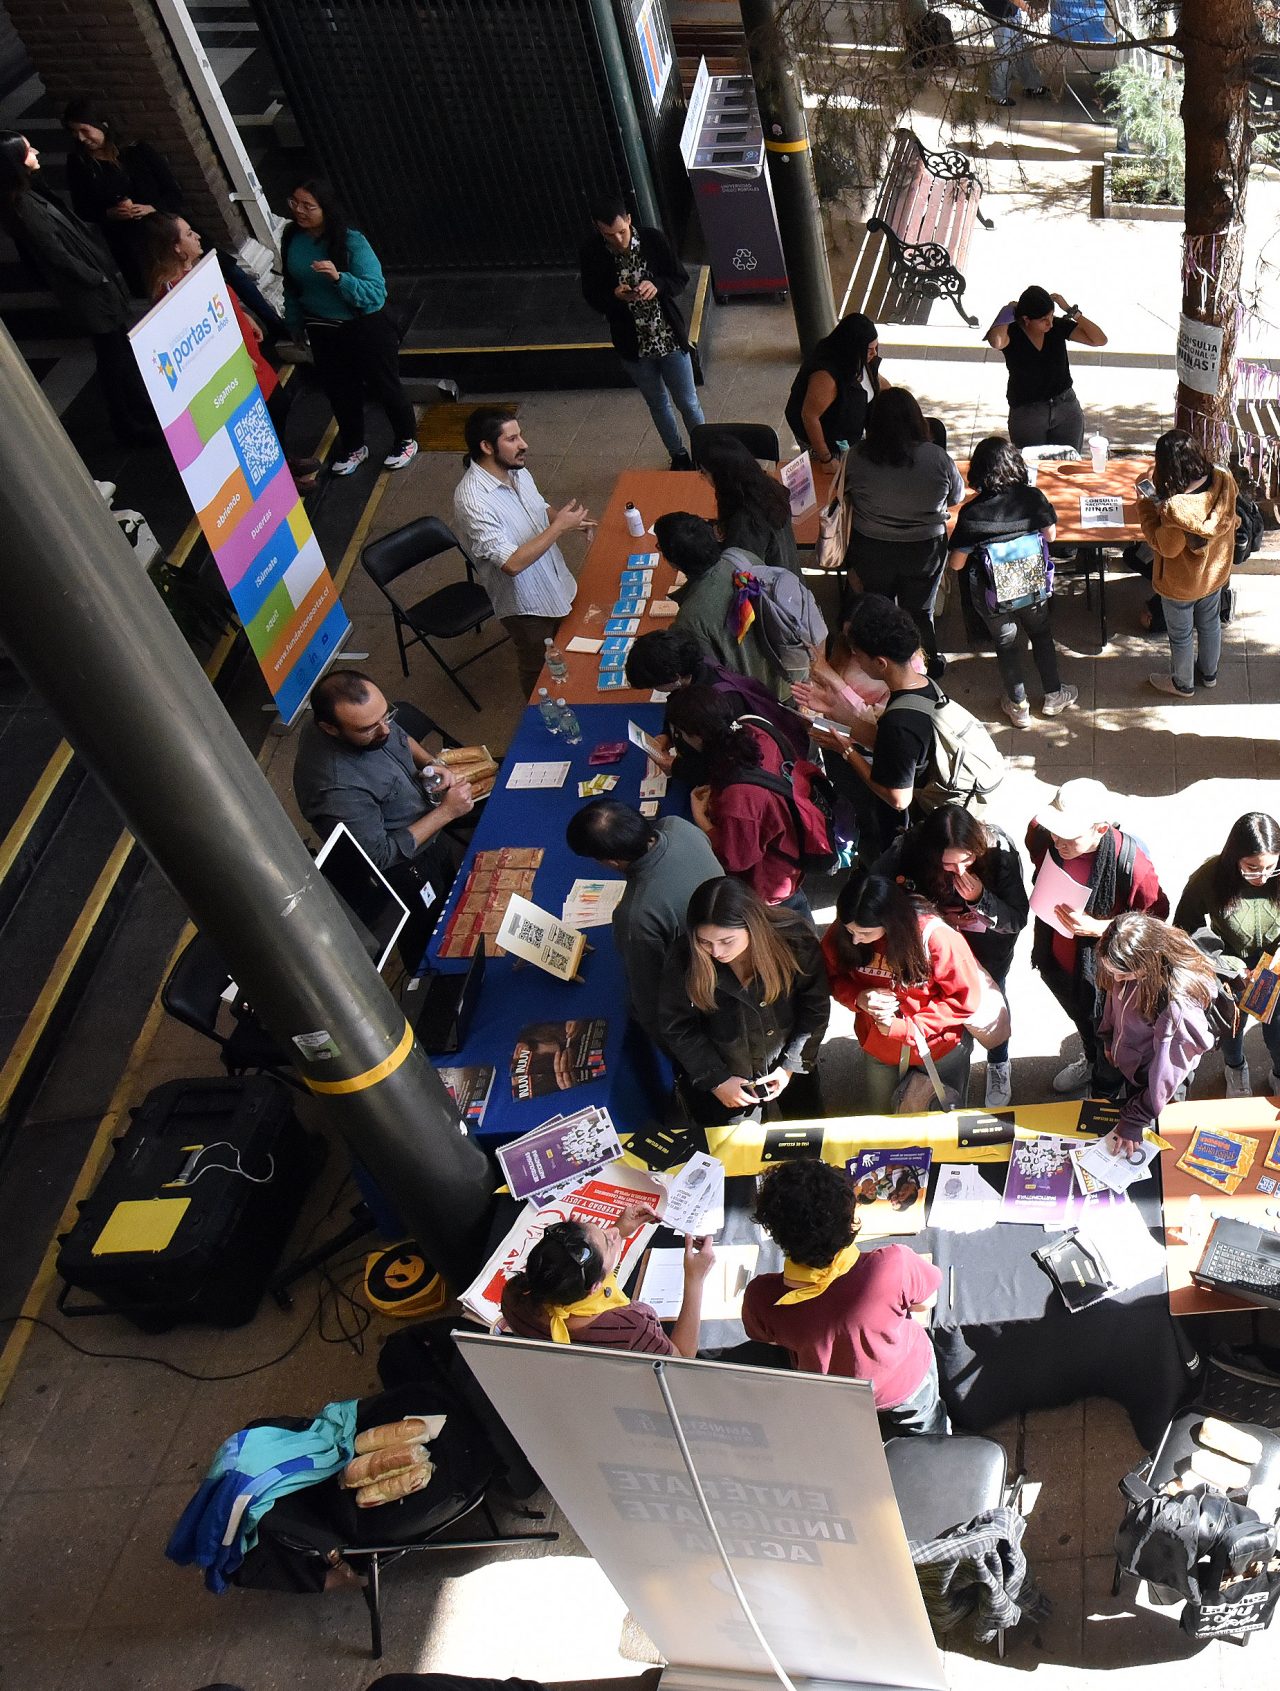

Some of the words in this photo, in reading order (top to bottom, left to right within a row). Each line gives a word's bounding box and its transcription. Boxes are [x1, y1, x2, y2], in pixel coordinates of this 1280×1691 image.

[173, 318, 212, 373] portas
[207, 294, 225, 323] 15
[213, 378, 239, 409] Sigamos
[216, 493, 241, 528] abriendo
[251, 509, 272, 539] puertas
[274, 586, 330, 672] www.fundacionportas.cl
[562, 1195, 582, 1206] JUSTI
[589, 1202, 615, 1213] VERDAD
